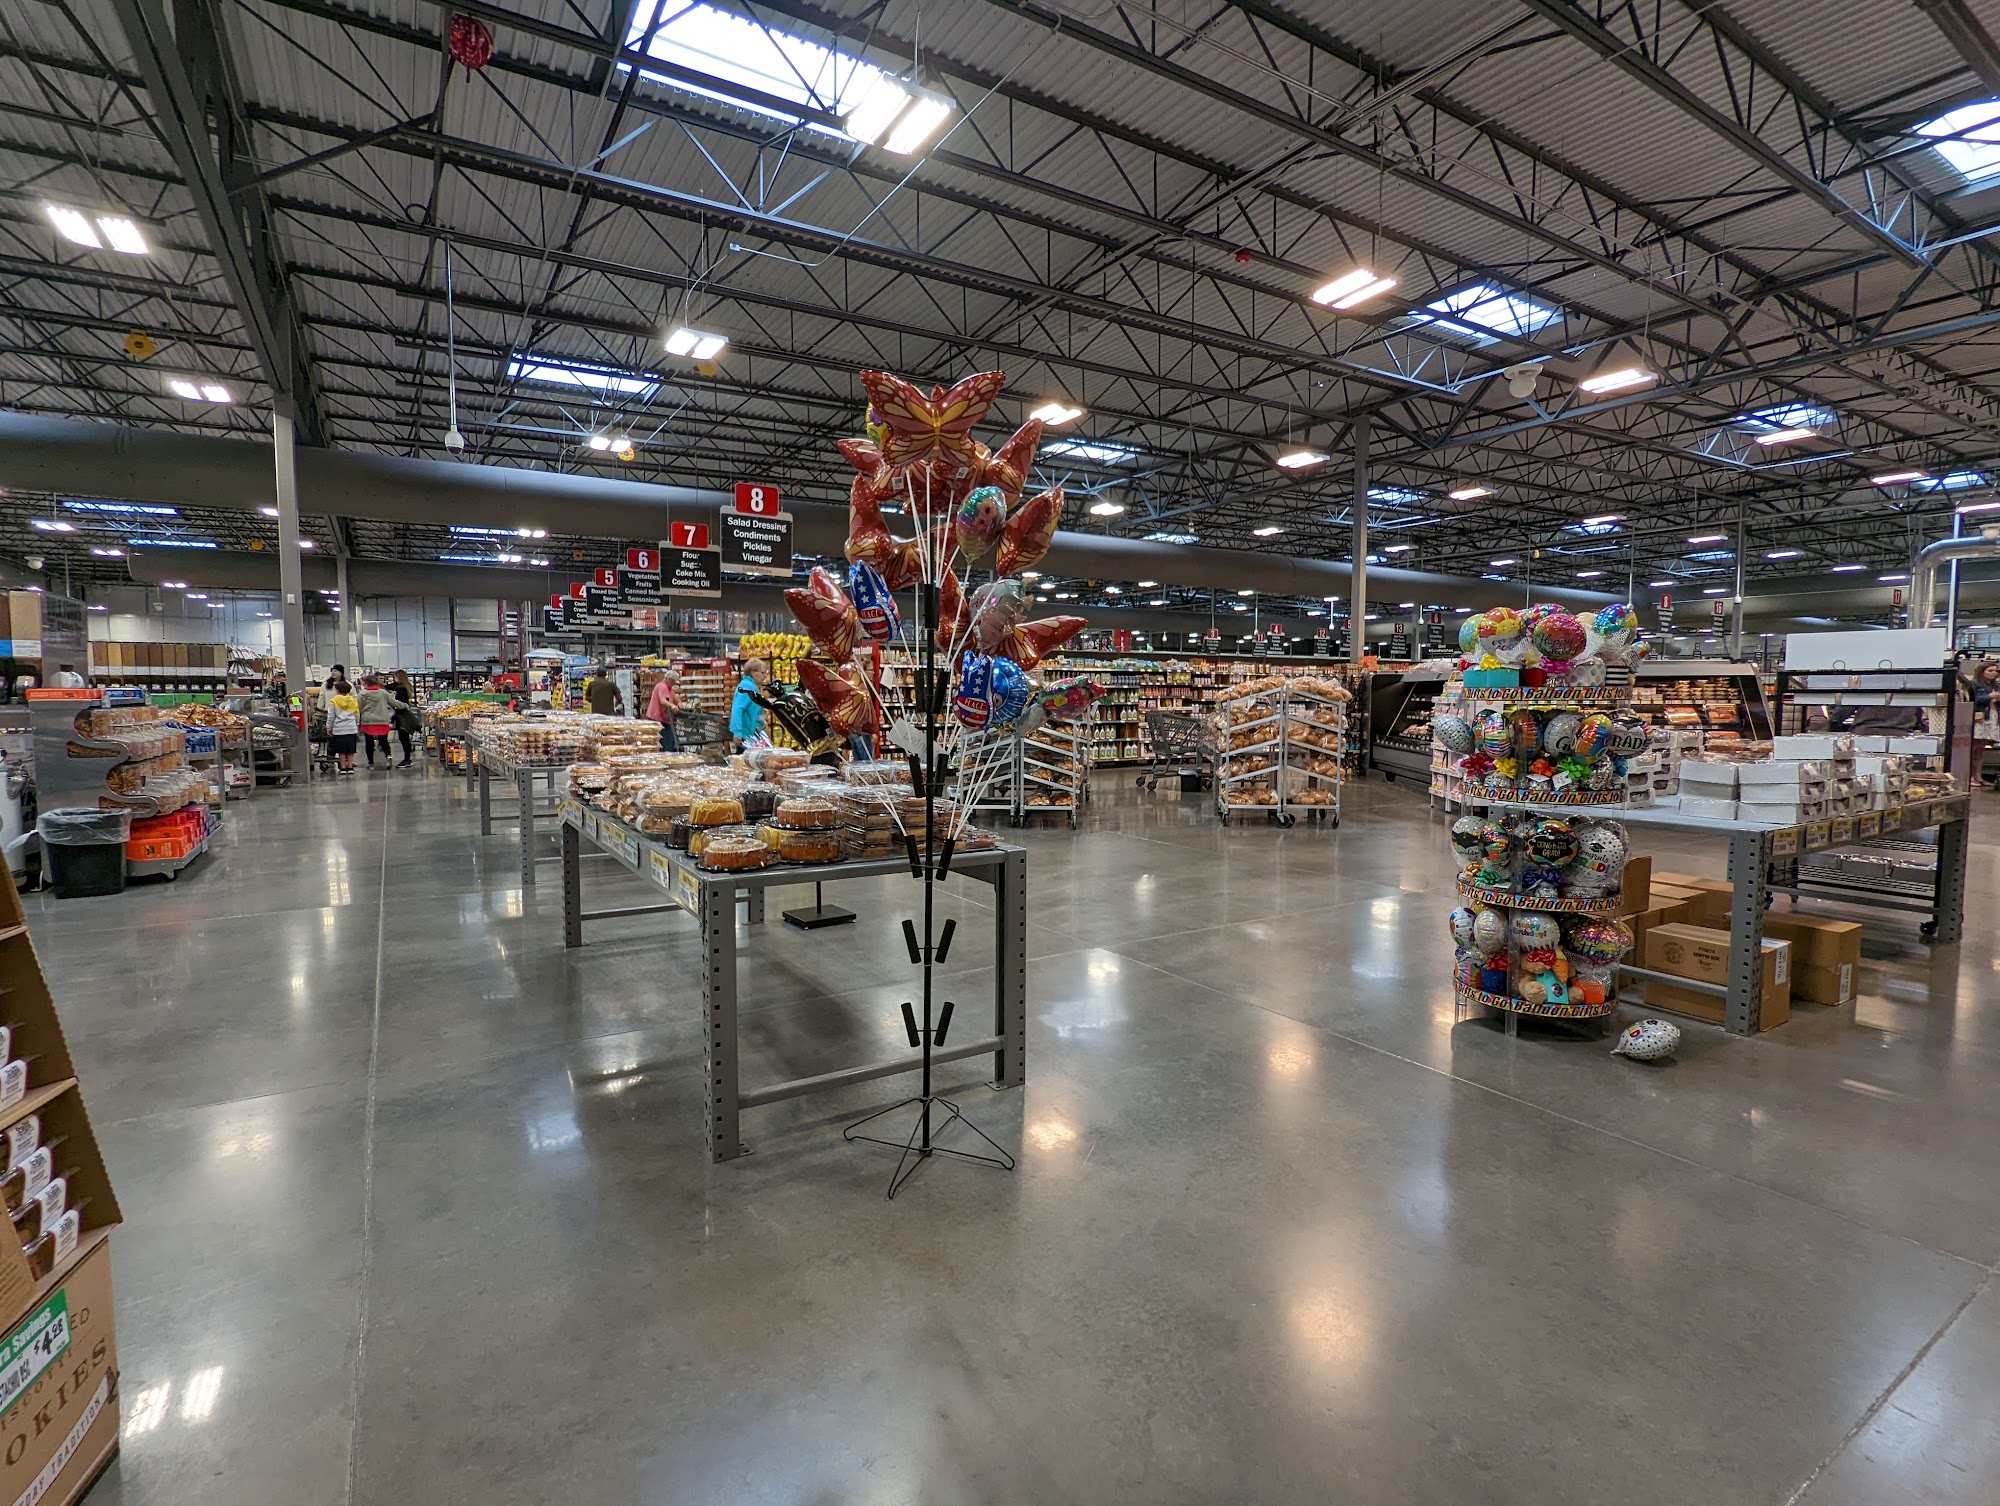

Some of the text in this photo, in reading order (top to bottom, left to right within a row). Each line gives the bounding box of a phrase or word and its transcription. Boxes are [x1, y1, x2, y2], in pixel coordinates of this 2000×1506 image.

[751, 488, 764, 512] 8
[728, 517, 787, 533] Salad Dressing
[684, 526, 695, 546] 7
[734, 529, 781, 542] Condiments
[743, 542, 772, 552] Pickles
[638, 552, 648, 568] 6
[742, 552, 773, 564] Vinegar
[605, 570, 614, 585] 5
[628, 572, 660, 580] Vegetables
[672, 578, 700, 588] Cooking
[579, 584, 587, 598] 4
[628, 596, 661, 604] Seasonings
[1274, 625, 1278, 633] 4
[1396, 624, 1402, 632] 13
[1487, 688, 1499, 699] to
[1502, 688, 1518, 699] Go
[1525, 688, 1581, 699] Balloon
[1585, 688, 1613, 699] Gifts
[1613, 689, 1624, 698] to
[1485, 788, 1496, 798] to
[1498, 790, 1514, 800] Go
[1521, 790, 1577, 803] Balloon
[1580, 791, 1607, 803] Gifts
[1481, 890, 1492, 901] to
[1496, 894, 1510, 905] Go
[1518, 897, 1573, 910] Balloon
[1576, 900, 1602, 911] Gifts
[1478, 991, 1488, 1002] to
[1492, 996, 1507, 1007] Go
[1514, 1001, 1568, 1017] Balloon
[1572, 1005, 1598, 1017] Gifts
[12, 1307, 52, 1353] Savings
[6, 1337, 106, 1466] OKIES
[51, 1398, 101, 1474] TRADITION
